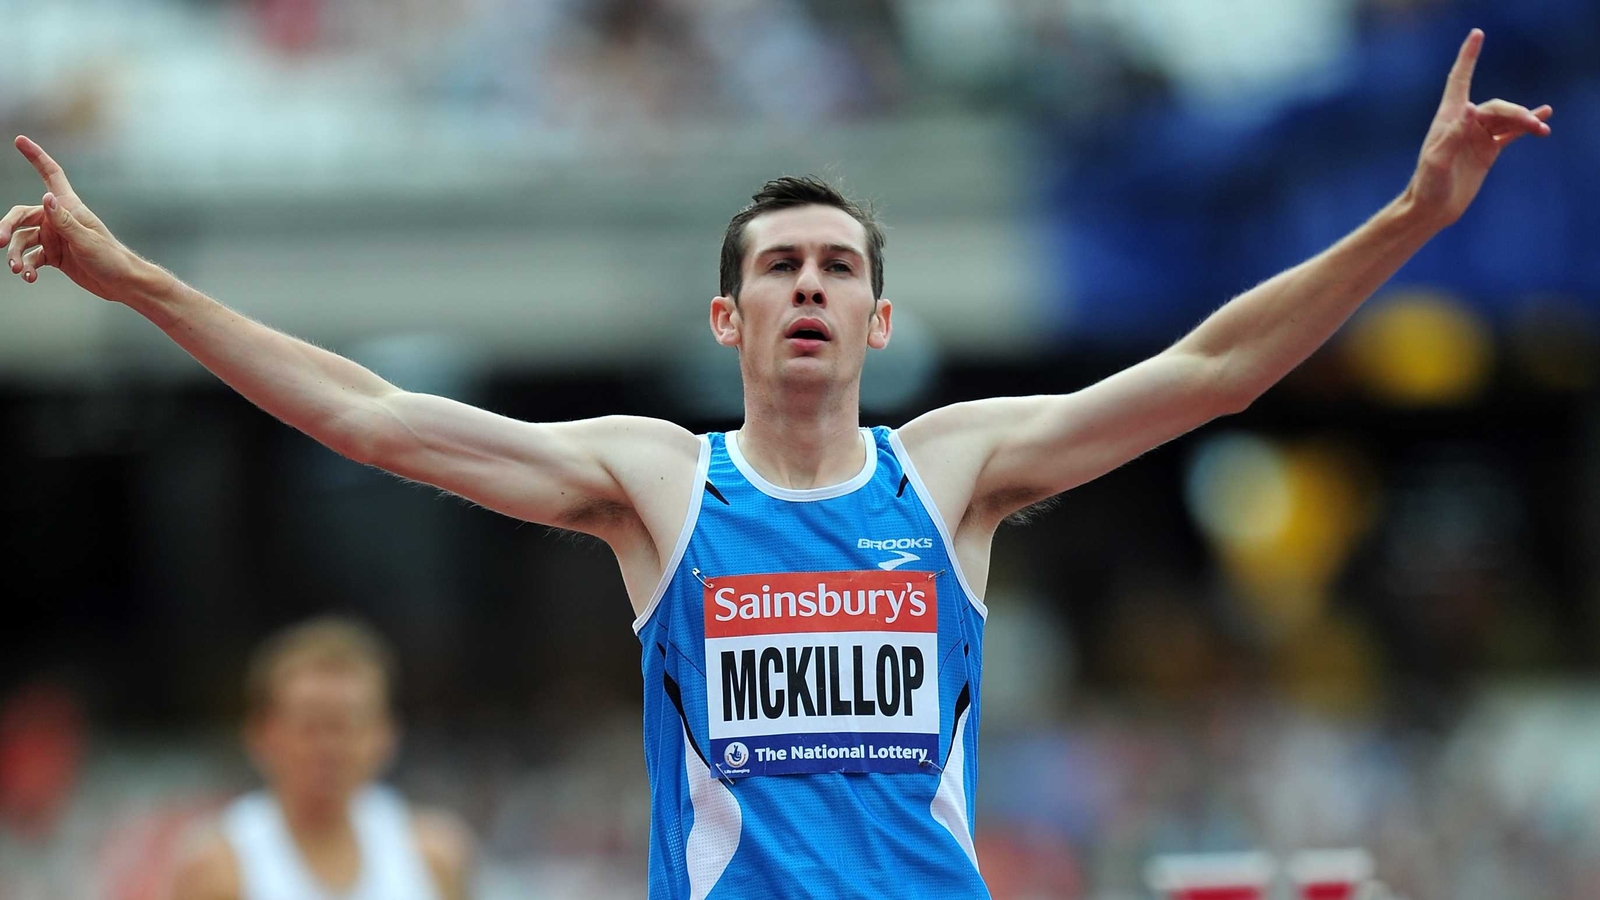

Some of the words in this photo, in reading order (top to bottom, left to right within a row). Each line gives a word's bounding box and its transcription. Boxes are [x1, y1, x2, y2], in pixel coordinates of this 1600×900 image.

[857, 537, 933, 550] BROOKS
[714, 582, 927, 624] Sainsbury's
[720, 644, 925, 722] MCKILLOP
[754, 747, 787, 762] The
[791, 745, 865, 760] National
[868, 744, 928, 763] Lottery
